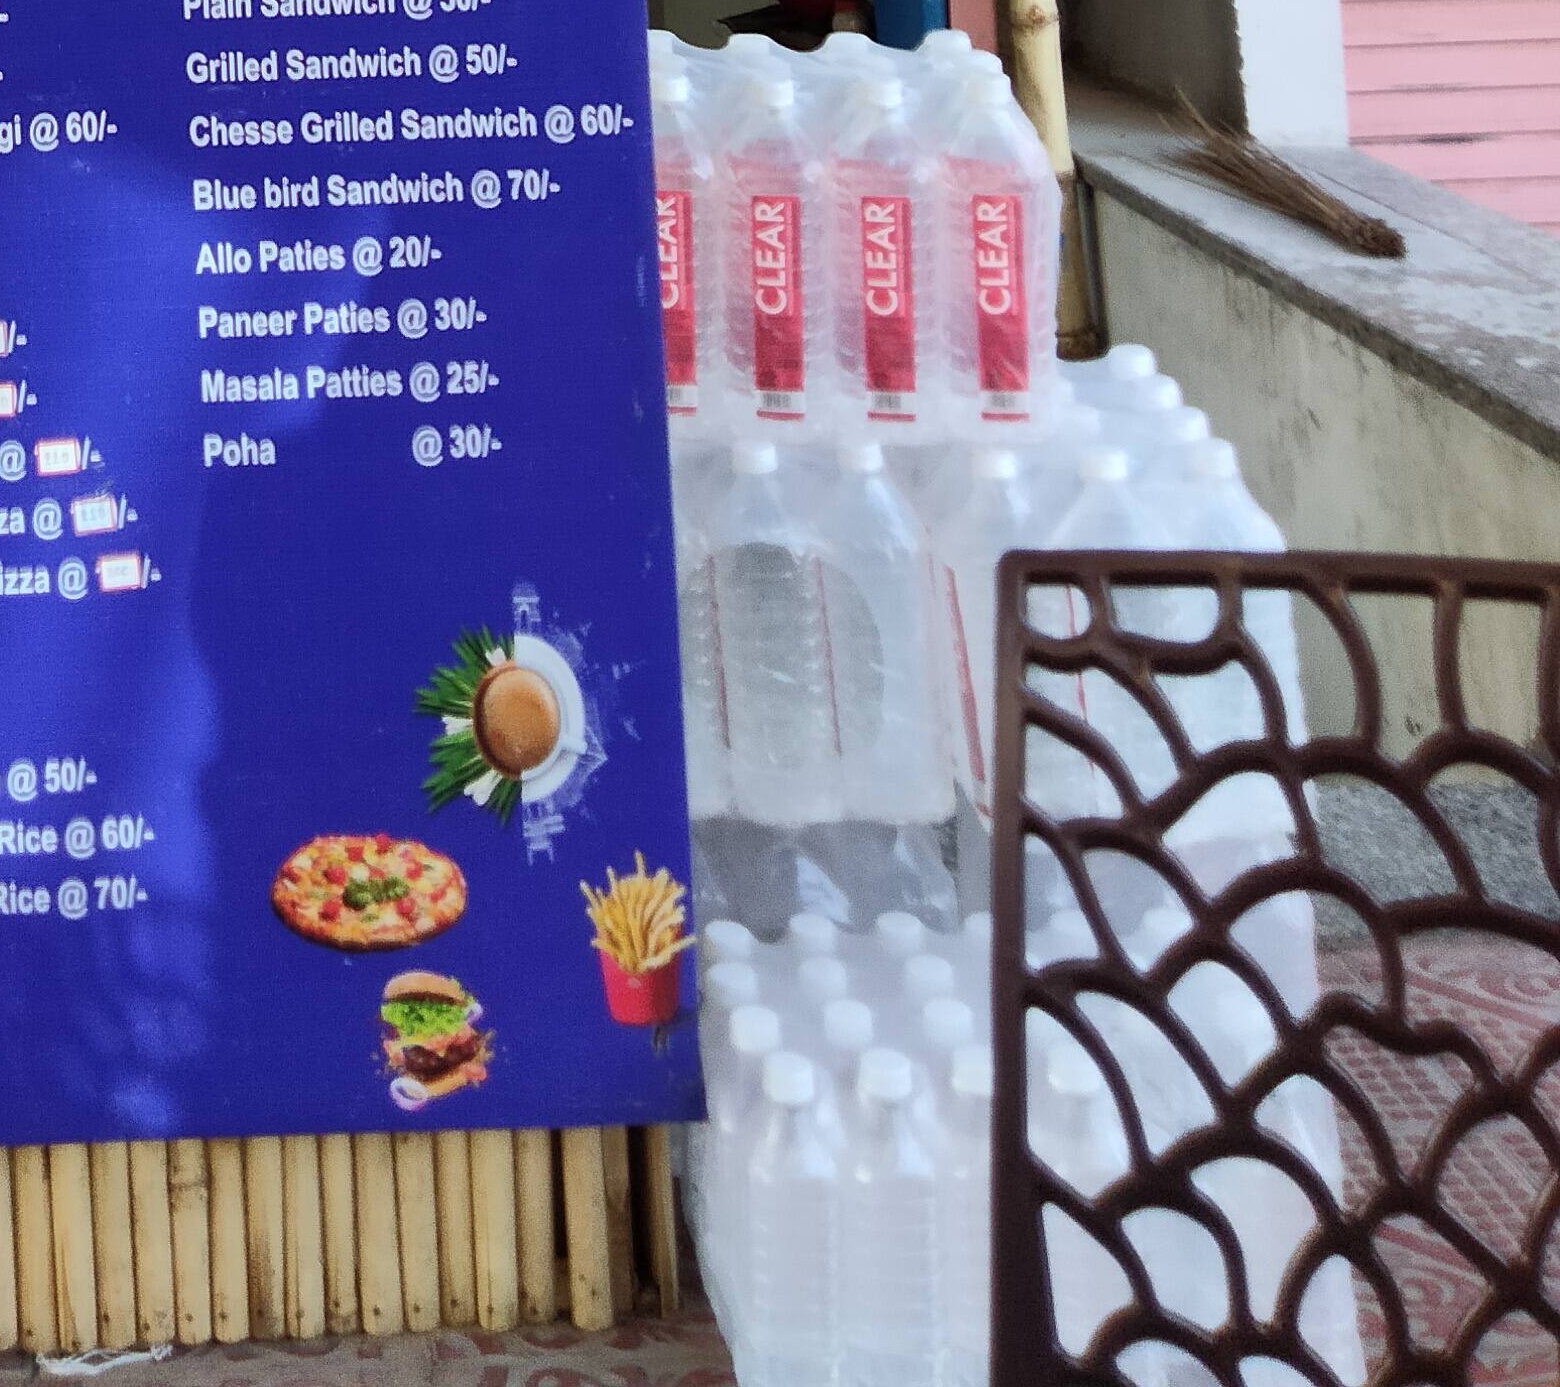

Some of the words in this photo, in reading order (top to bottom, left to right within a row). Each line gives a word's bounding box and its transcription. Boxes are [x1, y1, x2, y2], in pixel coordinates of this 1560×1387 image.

[185, 49, 278, 83] Grilled
[285, 44, 421, 81] Sandwich
[465, 42, 517, 75] 50/-
[753, 198, 787, 317] CLEAR
[864, 198, 899, 318] CLEAR
[976, 198, 1011, 317] CLEAR
[197, 305, 298, 339] Paneer
[302, 300, 390, 334] Paties
[433, 295, 487, 331] 30/-
[202, 431, 276, 468] Poha
[448, 423, 502, 459] 30/-
[43, 757, 97, 793] 50/-
[93, 874, 148, 910] 70/-
